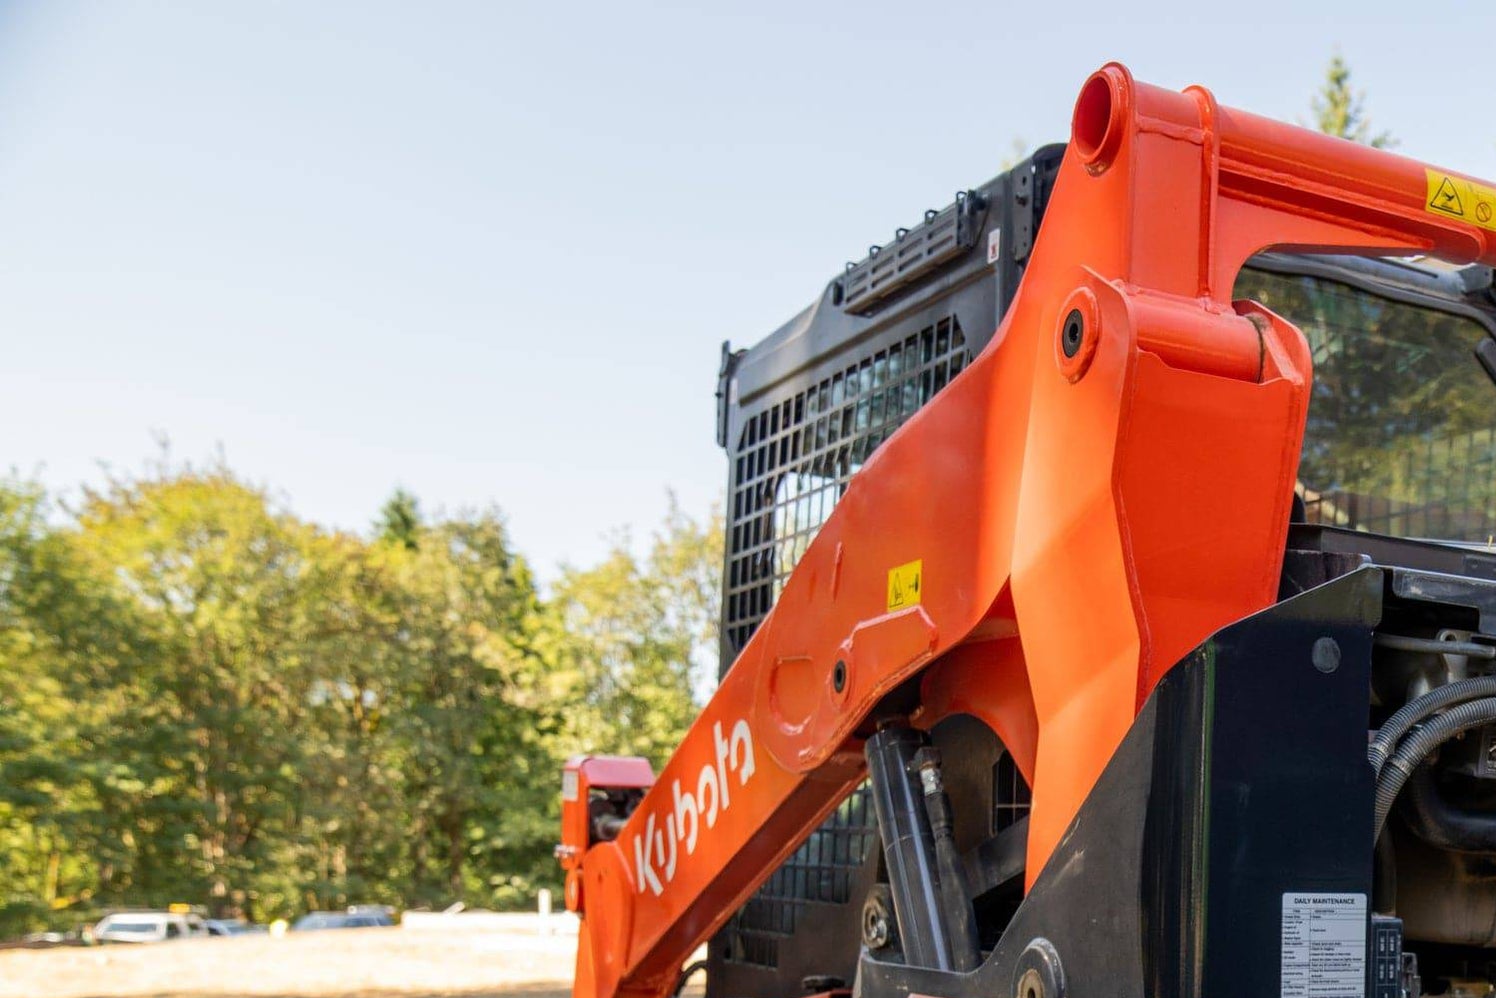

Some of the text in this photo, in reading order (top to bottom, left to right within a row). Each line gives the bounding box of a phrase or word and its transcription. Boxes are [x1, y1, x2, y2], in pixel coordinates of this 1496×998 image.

[634, 719, 755, 896] Kubota
[1294, 897, 1355, 905] DAILY MAINTENANCE
